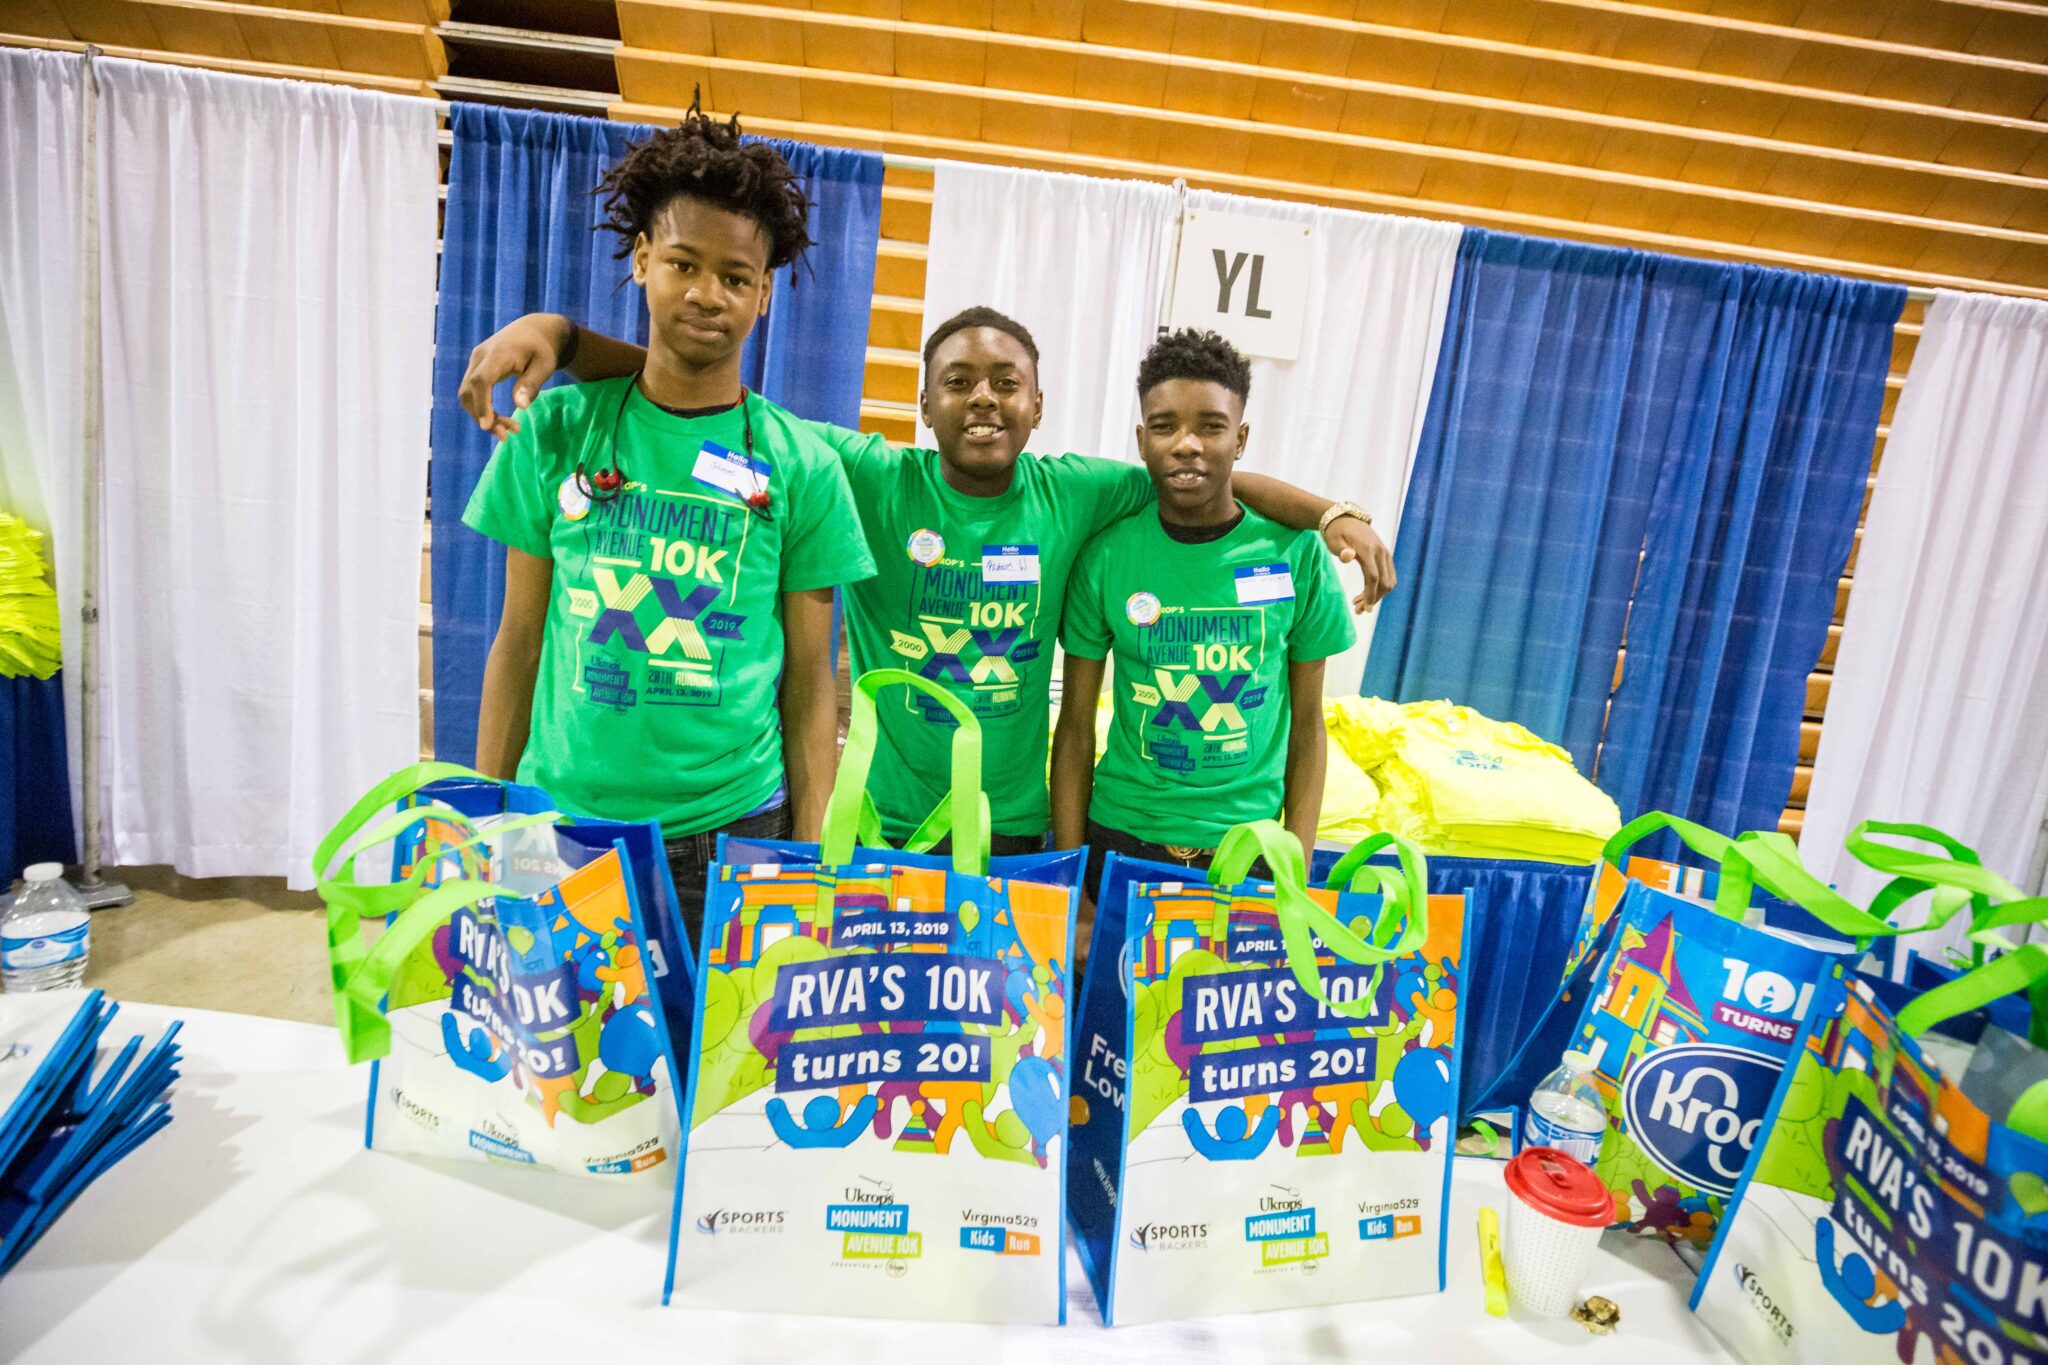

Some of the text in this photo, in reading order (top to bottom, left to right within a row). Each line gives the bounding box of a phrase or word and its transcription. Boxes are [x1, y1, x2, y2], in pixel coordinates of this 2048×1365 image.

[1212, 248, 1272, 320] YL
[727, 450, 749, 464] Hello
[597, 493, 735, 547] MONUMENT
[594, 530, 646, 559] AVENUE
[649, 536, 729, 584] 10K
[919, 596, 965, 618] AVENUE
[968, 601, 1030, 628] 10K
[709, 618, 737, 632] 2019
[1148, 615, 1253, 644] MONUMENT
[897, 637, 922, 653] 2000
[1147, 644, 1190, 664] AVENUE
[1192, 643, 1254, 672] 10K
[645, 686, 673, 696] APRIL
[1202, 753, 1224, 763] APRIL
[841, 921, 949, 939] APRIL 13, 2019
[1235, 939, 1278, 954] APRIL
[512, 977, 570, 1025] 0K
[787, 964, 992, 1020] RVA'S 10K
[1195, 979, 1297, 1032] RVA'S
[1720, 1006, 1793, 1040] TURNS
[791, 1042, 981, 1083] turns 20!
[1090, 1033, 1127, 1079] Fre
[1201, 1047, 1366, 1094] turns 20!
[583, 1135, 660, 1164] Virginia529
[595, 1155, 657, 1174] Kids Run
[1943, 1156, 1989, 1196] 2019
[721, 1210, 785, 1225] SPORTS
[962, 1208, 1038, 1228] Virginia529
[1358, 1198, 1420, 1215] Virginia529
[1844, 1115, 2048, 1319] RVA'S 10K
[729, 1225, 784, 1234] BACKERS
[830, 1209, 904, 1229] MONUMENT
[1249, 1214, 1312, 1239] MONUMENT
[1367, 1220, 1413, 1236] Kids Run
[970, 1230, 1030, 1251] Kids Run
[1150, 1224, 1208, 1240] SPORTS
[846, 1236, 918, 1255] AVENUE 10K
[1159, 1240, 1208, 1250] BACKERS
[1265, 1237, 1328, 1260] AVENUE 10K
[1843, 1196, 1929, 1306] turns
[1748, 1278, 1794, 1337] SPORTS
